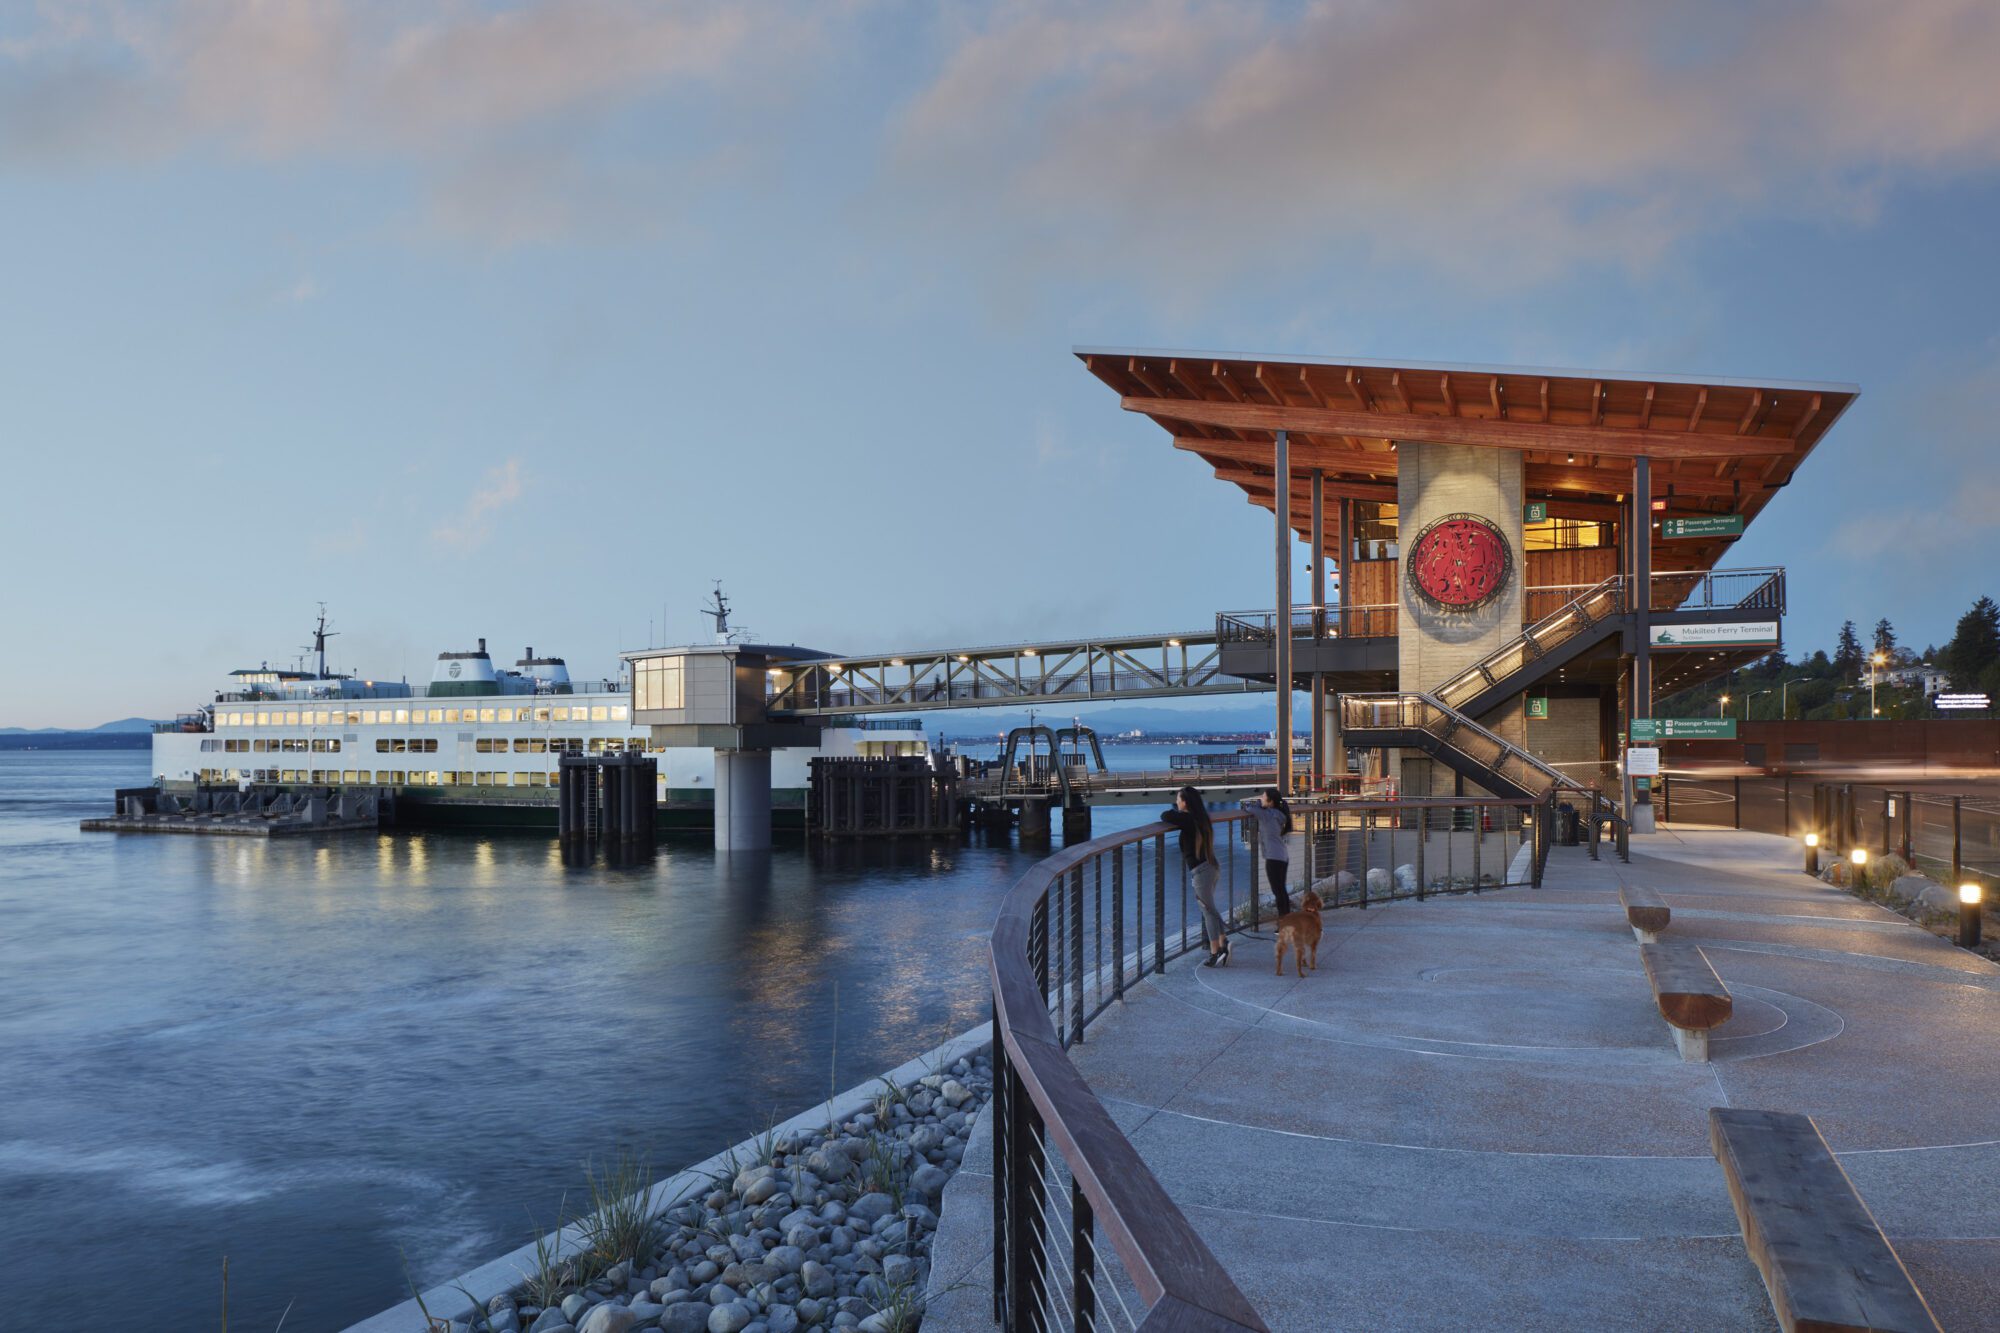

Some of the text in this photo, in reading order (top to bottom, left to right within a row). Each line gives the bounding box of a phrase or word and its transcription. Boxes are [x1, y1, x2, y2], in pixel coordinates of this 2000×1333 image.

[1682, 625, 1774, 635] Mukilteo Ferry Terminal
